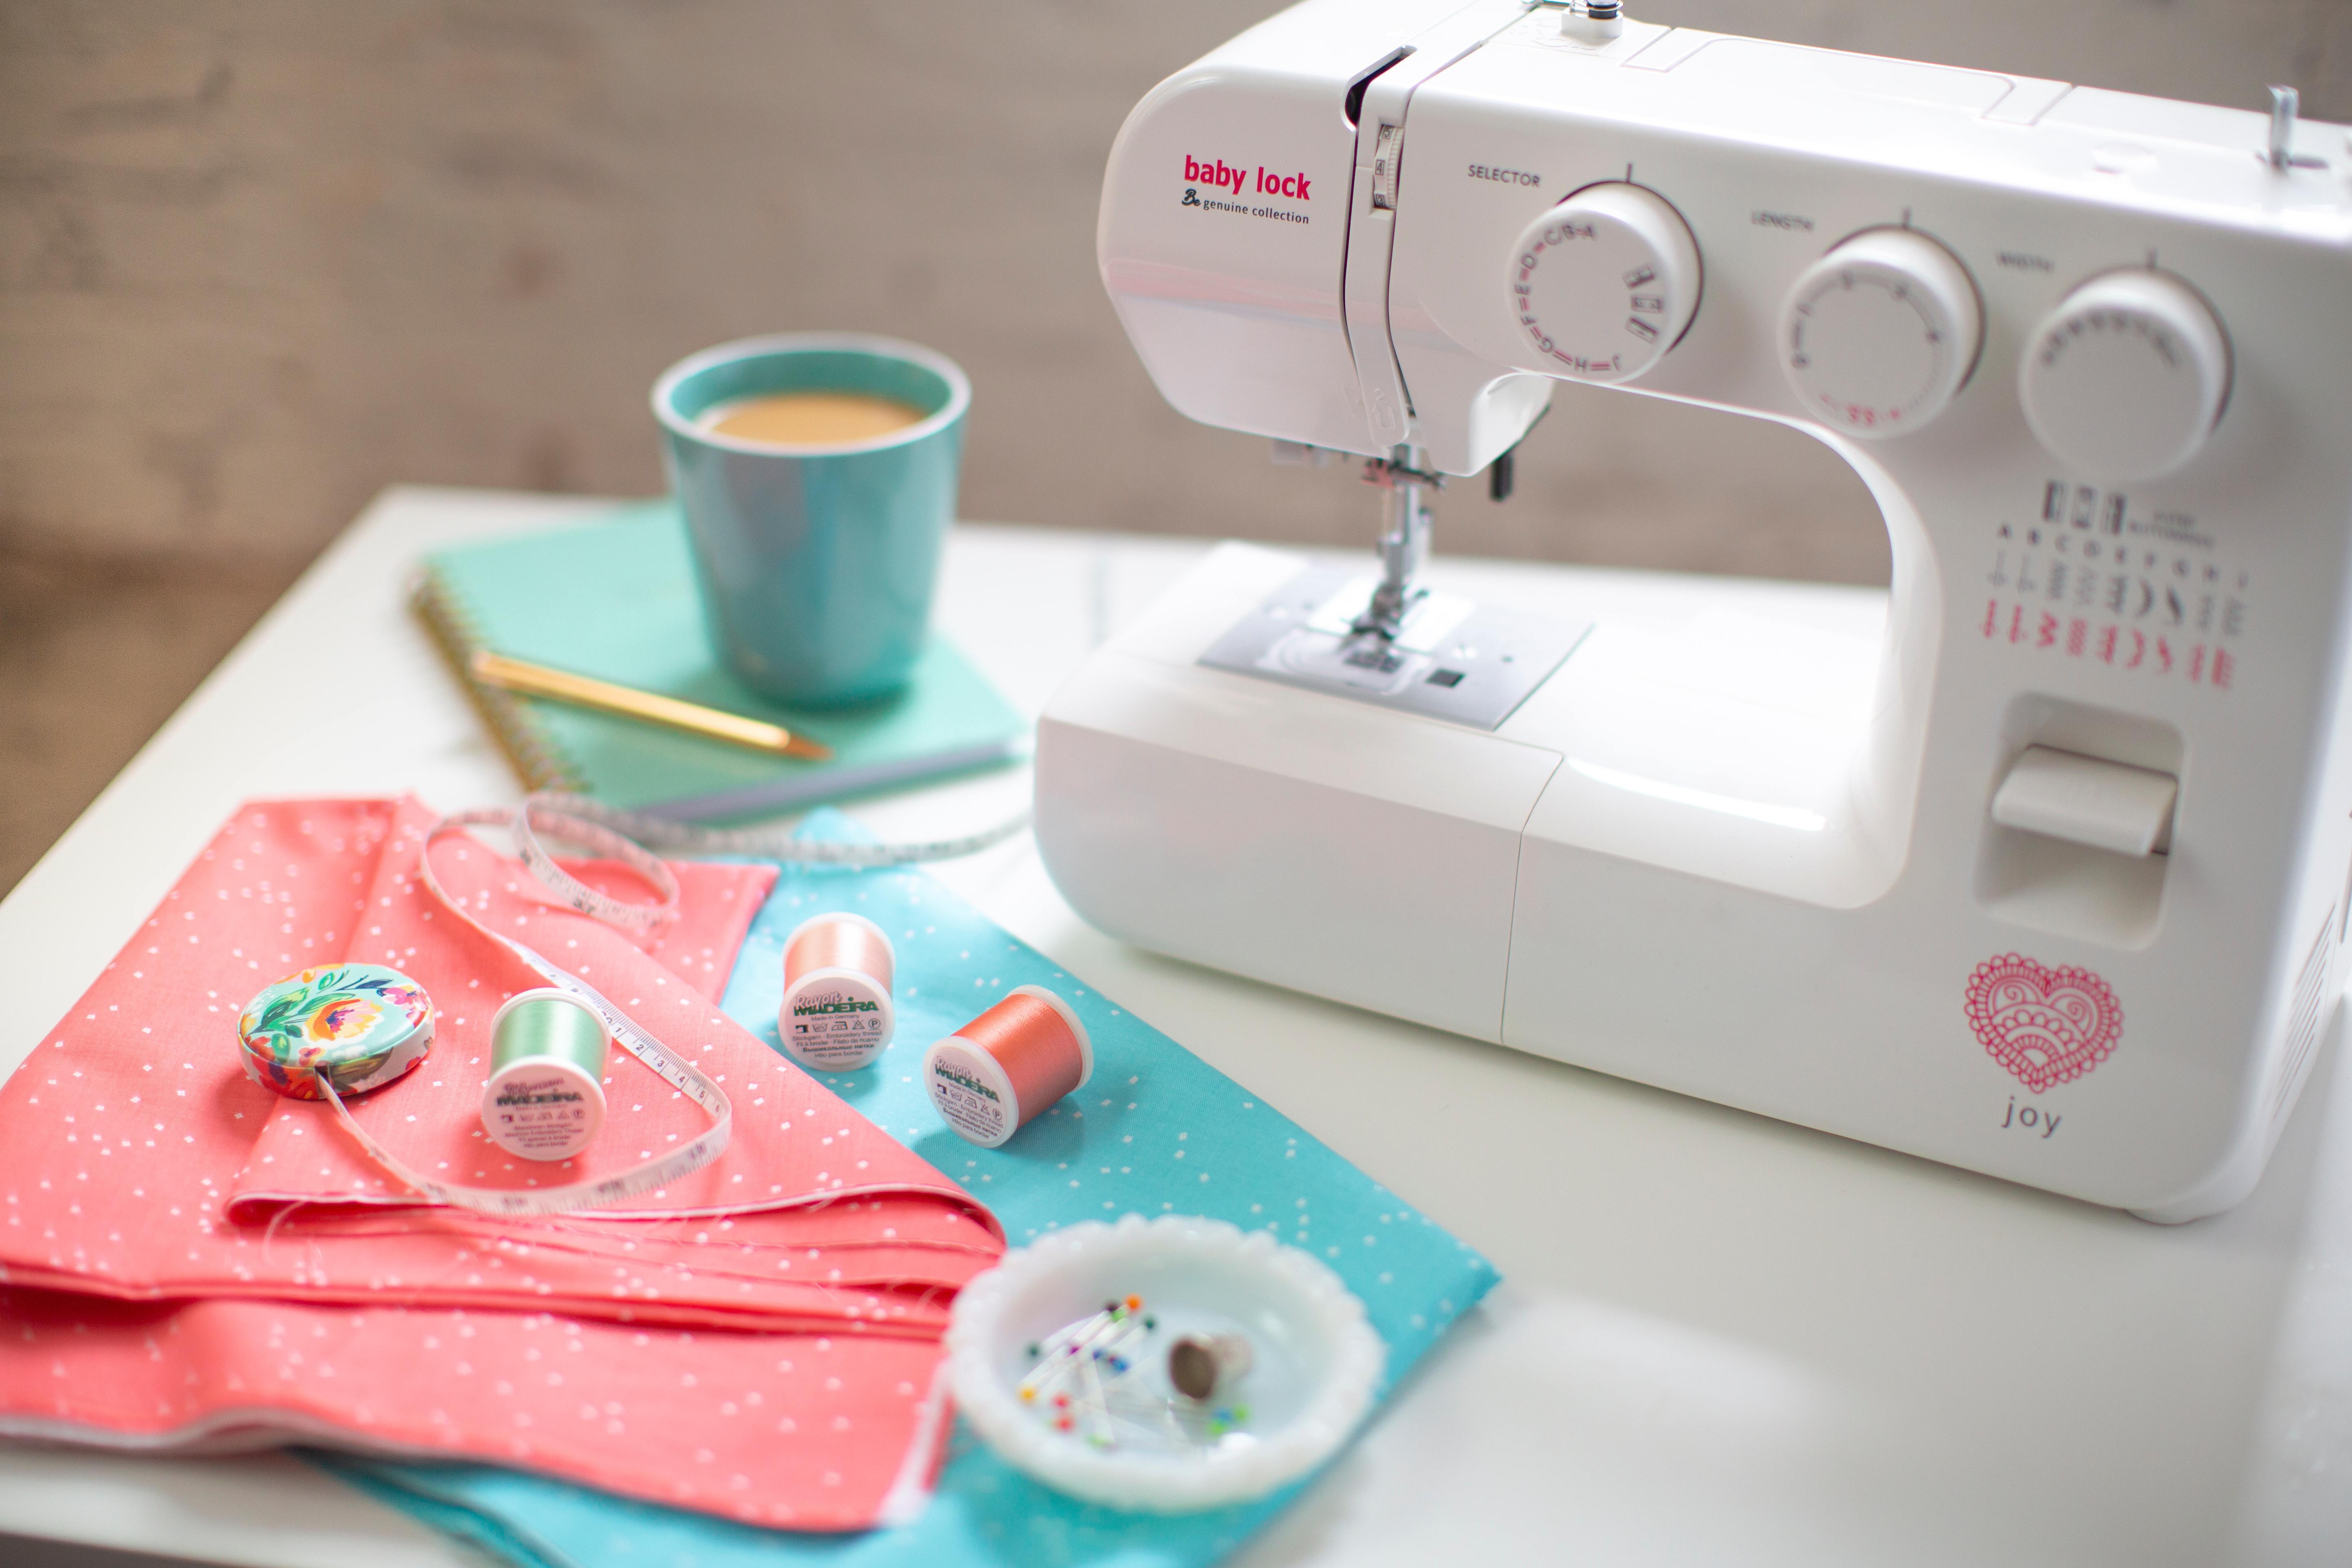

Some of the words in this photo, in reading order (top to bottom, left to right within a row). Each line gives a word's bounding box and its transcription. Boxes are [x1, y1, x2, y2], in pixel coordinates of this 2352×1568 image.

[1384, 126, 1390, 137] 5
[1377, 162, 1382, 174] 4
[1185, 154, 1247, 195] baby
[1256, 166, 1311, 200] lock
[1468, 165, 1541, 188] SELECTOR
[1182, 188, 1201, 206] Be
[1203, 200, 1248, 214] genuine
[1252, 207, 1308, 224] collection
[1378, 196, 1383, 205] 3
[1521, 254, 1536, 270] D
[1515, 284, 1530, 295] E
[1520, 316, 1536, 325] F
[1538, 337, 1553, 352] G
[1574, 357, 1588, 371] H
[796, 991, 842, 1011] Rayon
[937, 1056, 972, 1080] Rayon
[935, 1092, 957, 1106] Stickgarn
[961, 1104, 987, 1121] Embroidery
[948, 1105, 962, 1114] broder
[966, 1112, 978, 1122] Filato
[2001, 1095, 2062, 1138] joy
[953, 1117, 961, 1125] Hilo
[974, 1128, 989, 1138] bordar
[982, 1127, 997, 1137] нитки
